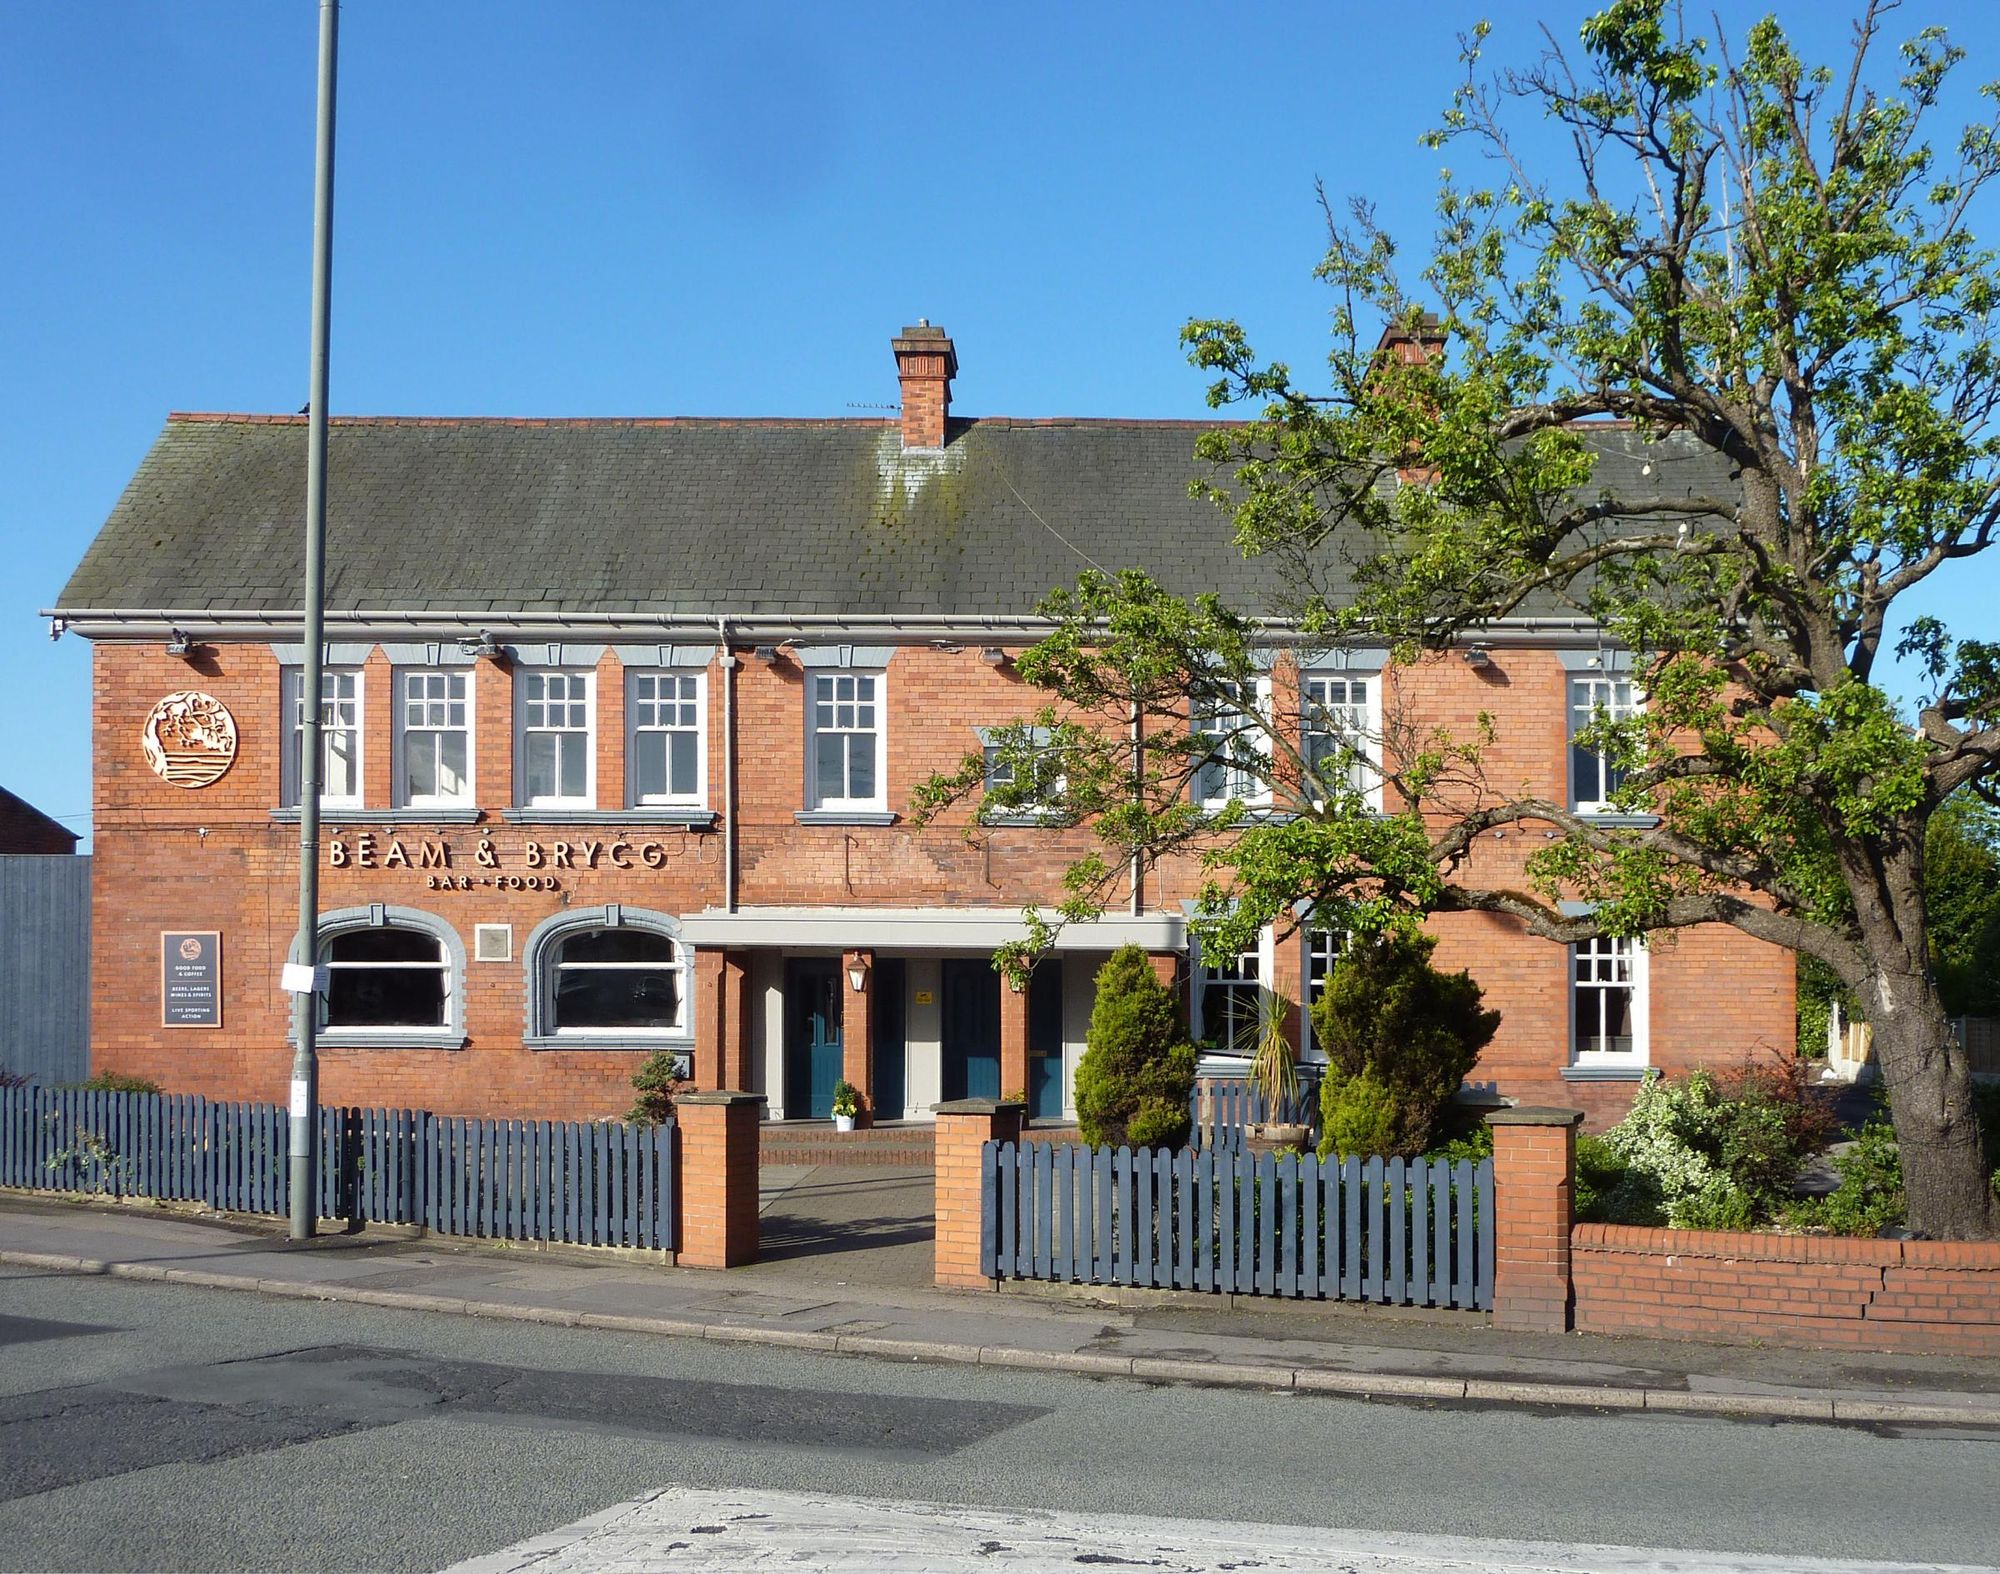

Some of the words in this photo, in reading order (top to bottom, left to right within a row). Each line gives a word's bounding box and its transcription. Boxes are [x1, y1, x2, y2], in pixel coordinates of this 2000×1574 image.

[474, 839, 495, 866] &
[525, 841, 662, 867] BRYCG
[426, 875, 468, 888] BAR
[495, 875, 555, 888] FOOD
